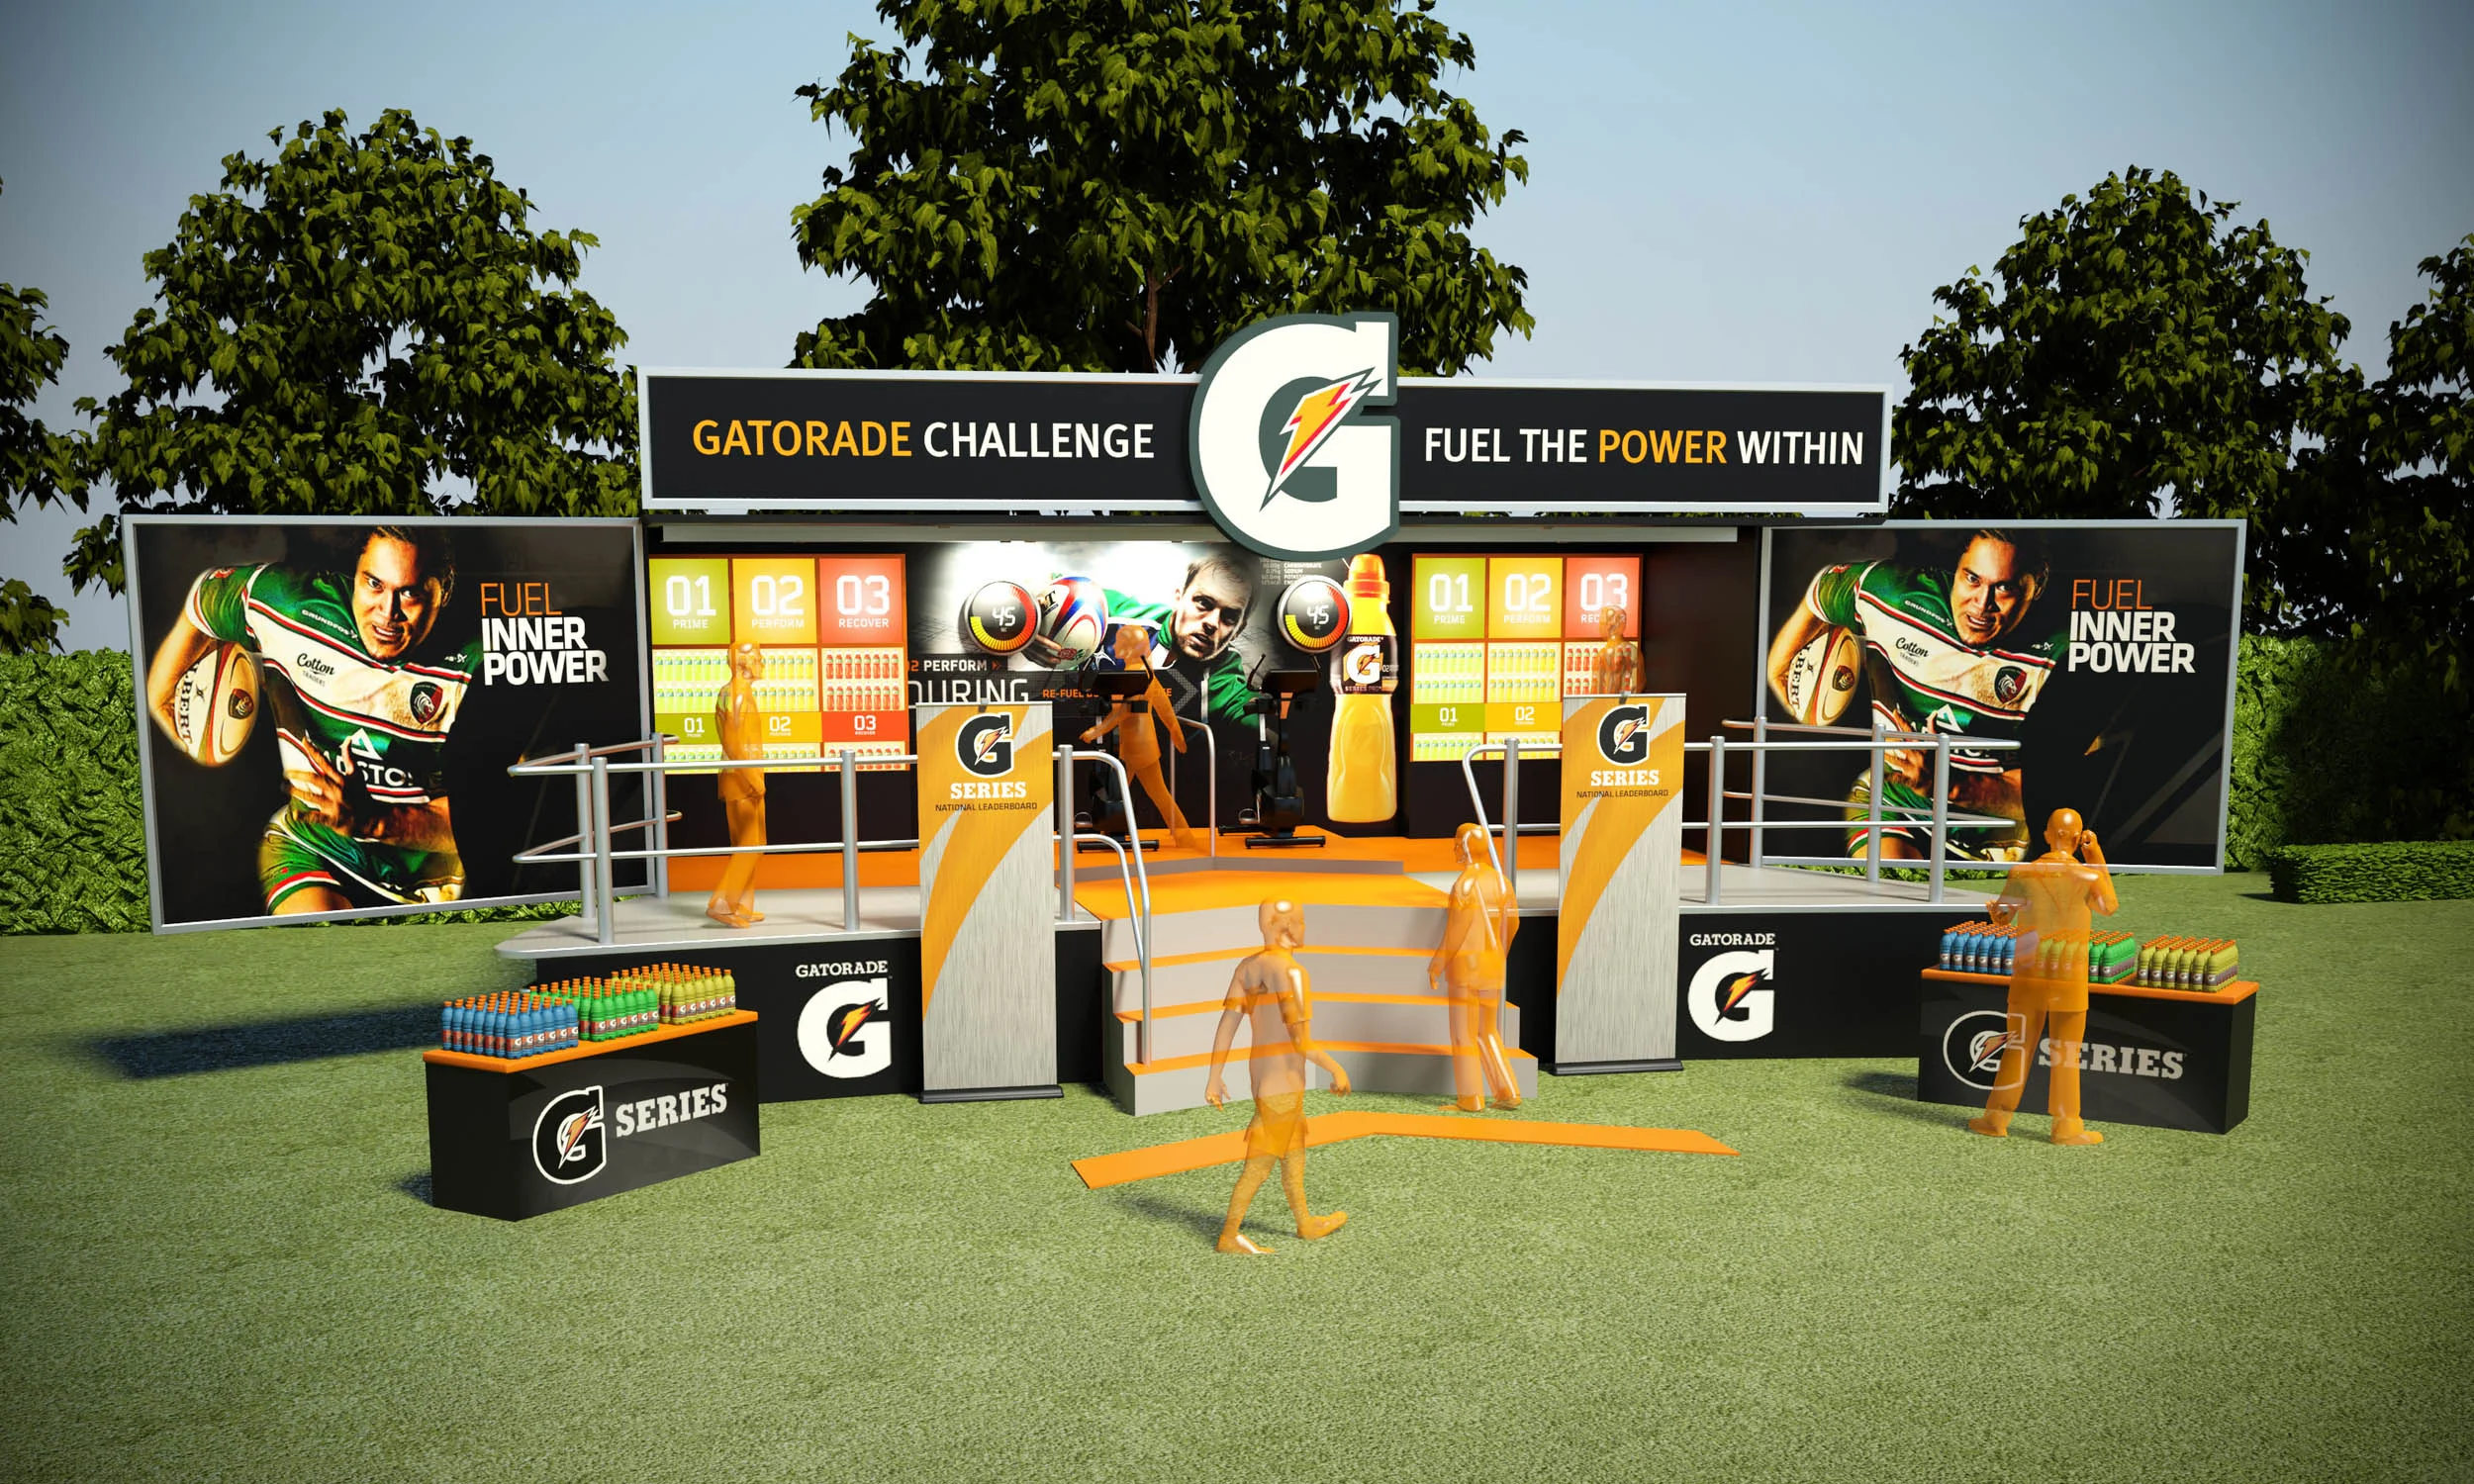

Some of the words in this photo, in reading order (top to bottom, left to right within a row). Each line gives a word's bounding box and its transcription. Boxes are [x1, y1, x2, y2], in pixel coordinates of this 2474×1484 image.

[693, 418, 911, 457] GATORADE
[923, 421, 1155, 459] CHALLENGE
[1192, 315, 1399, 560] G
[1425, 426, 1510, 463] FUEL
[1519, 427, 1587, 464] THE
[1597, 428, 1727, 465] POWER
[1737, 430, 1864, 465] WITHIN
[480, 582, 562, 616] FUEL
[666, 575, 716, 616] 01
[751, 575, 804, 615] 02
[836, 575, 891, 615] 03
[1429, 574, 1474, 612] 01
[1504, 573, 1551, 611] 02
[1580, 573, 1628, 610] 03
[2071, 579, 2153, 610] FUEL
[751, 618, 805, 629] PERFORM
[838, 617, 890, 628] RECOVER
[992, 605, 1017, 627] 45
[1306, 604, 1330, 625] 45
[1434, 614, 1466, 625] PRIME
[1503, 614, 1551, 624] PERFORM
[2069, 611, 2176, 641] INNER
[481, 616, 589, 651] INNER
[1895, 637, 1929, 658] Cotton
[296, 653, 335, 676] Cotton
[483, 649, 610, 686] POWER
[923, 659, 988, 672] PERFORM
[1347, 645, 1380, 685] G
[2067, 642, 2196, 673] POWER
[1042, 688, 1084, 698] RE-FUEL
[684, 717, 706, 733] 01
[769, 715, 792, 732] 02
[854, 714, 877, 731] 03
[1439, 706, 1458, 722] 01
[1514, 705, 1535, 721] 02
[955, 712, 1014, 779] G
[1596, 703, 1651, 767] G
[950, 782, 1027, 799] SERIES
[1590, 770, 1661, 787] SERIES
[1615, 788, 1669, 797] LEADERBOARD
[935, 803, 976, 812] NATIONAL
[978, 802, 1038, 811] LEADERBOARD
[1689, 933, 1776, 946] GATORADE
[796, 961, 888, 978] GATORADE
[1687, 950, 1774, 1043] G
[798, 977, 892, 1079] G
[1944, 1010, 2027, 1090] G
[2039, 1038, 2184, 1079] SERIES
[532, 1085, 607, 1185] G
[616, 1083, 727, 1138] SERIES
